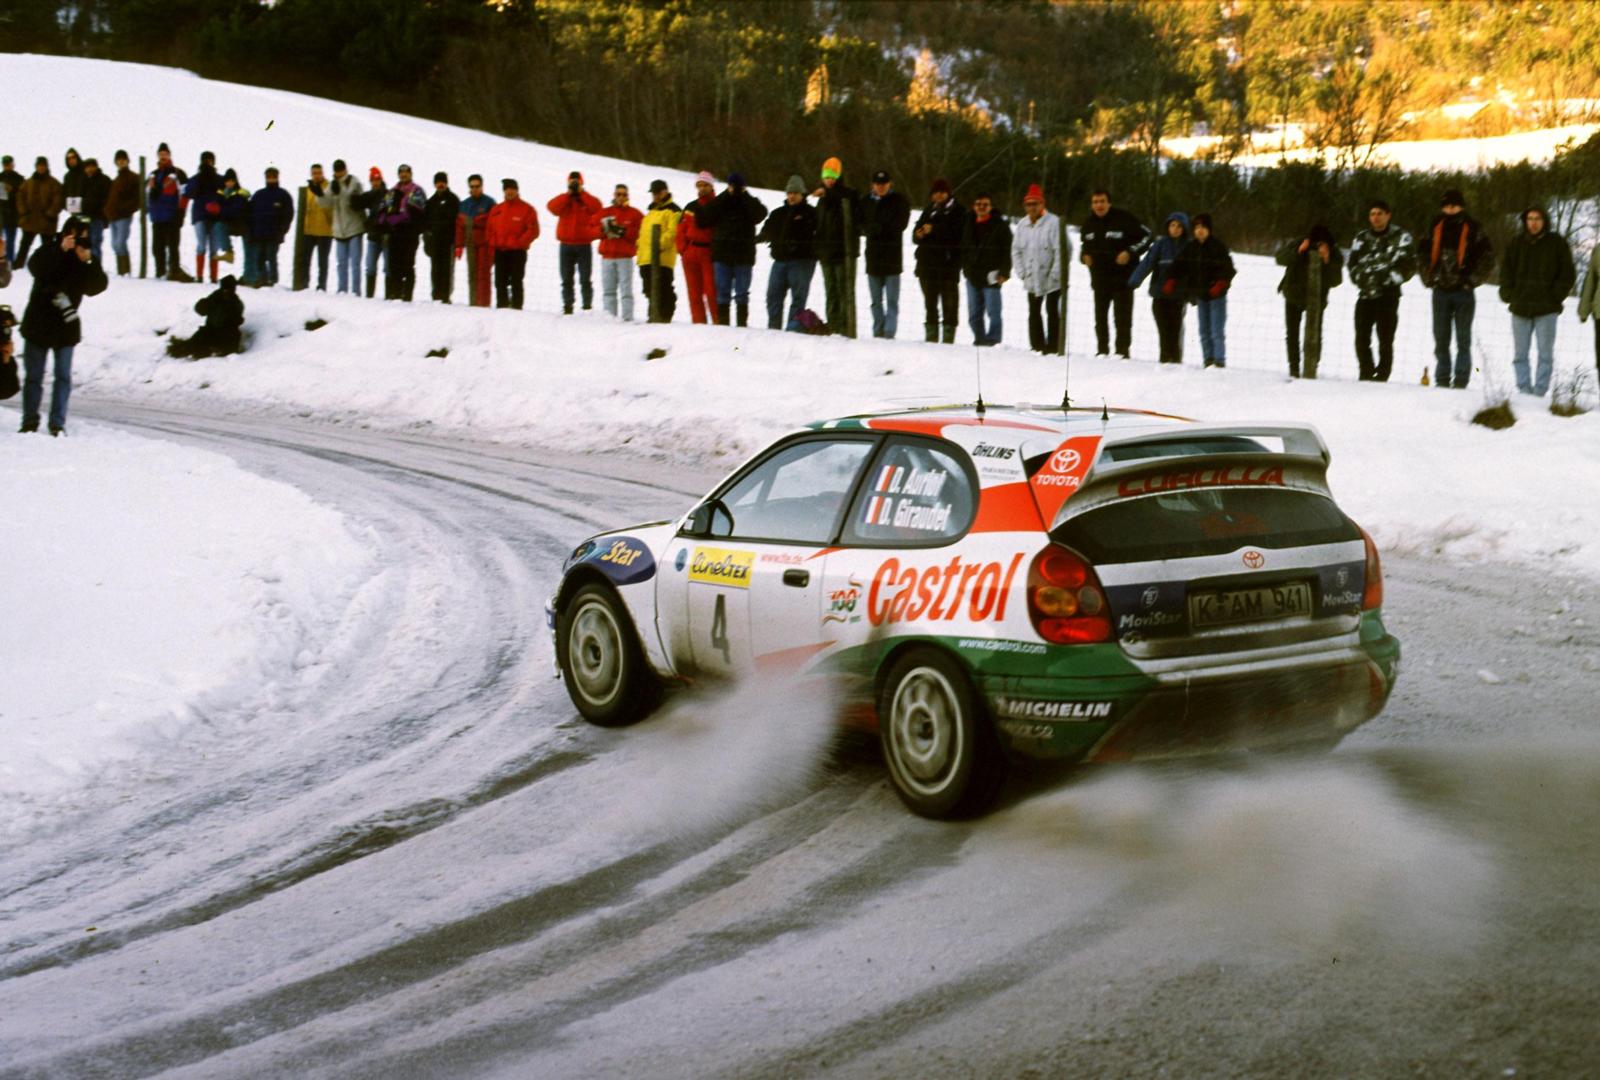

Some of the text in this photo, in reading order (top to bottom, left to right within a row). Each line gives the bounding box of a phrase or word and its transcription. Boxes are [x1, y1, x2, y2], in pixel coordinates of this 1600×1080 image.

[972, 442, 1016, 460] ÖHLINS
[1036, 474, 1080, 487] TOYOTA
[893, 498, 952, 531] Giraudet
[600, 541, 641, 566] Star
[867, 553, 1025, 627] Castrol
[712, 594, 731, 664] 4
[1119, 611, 1182, 629] MoviStar
[1008, 701, 1112, 717] MICHELIN
